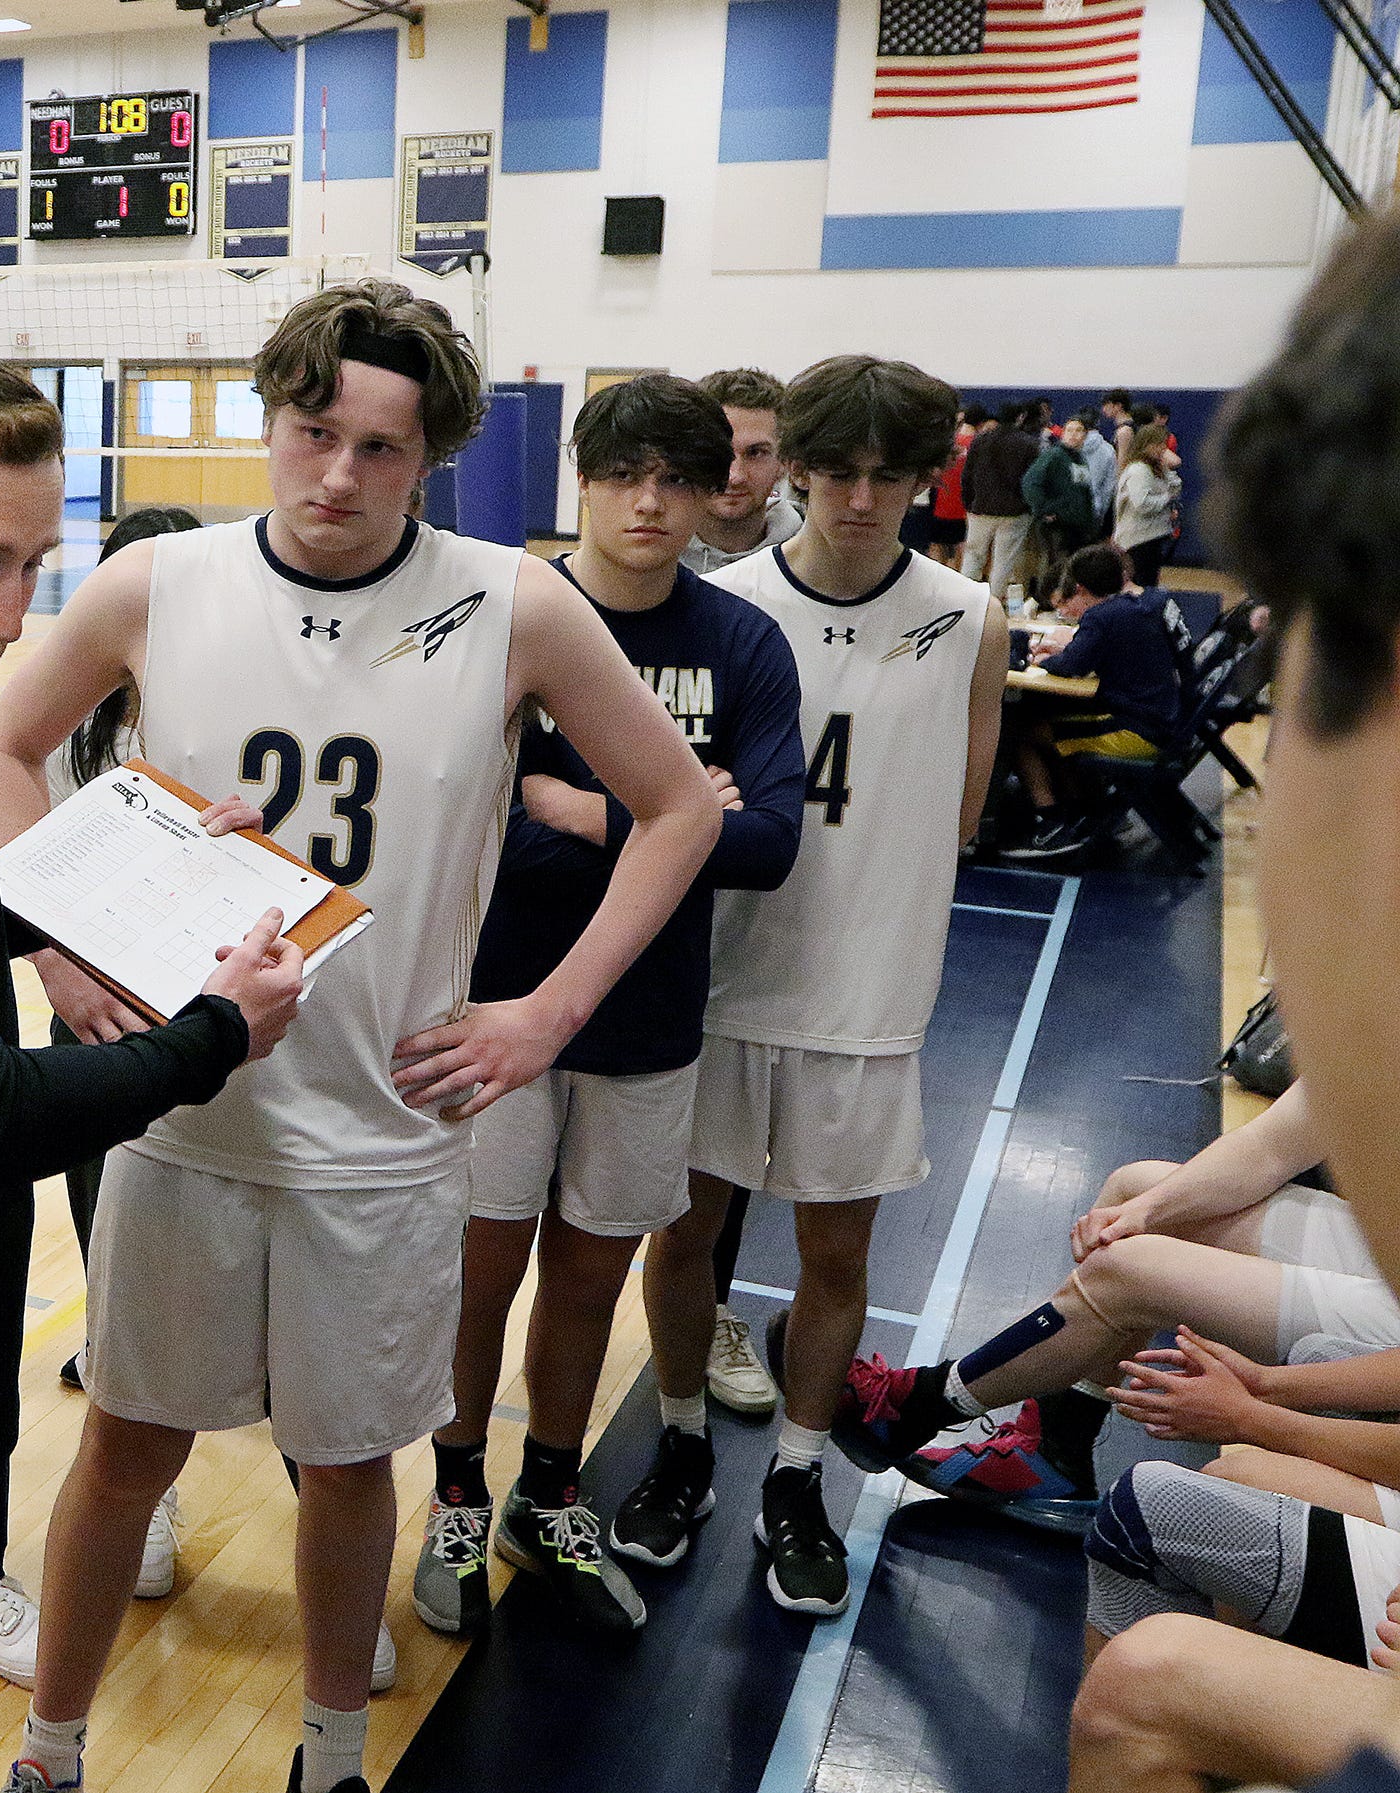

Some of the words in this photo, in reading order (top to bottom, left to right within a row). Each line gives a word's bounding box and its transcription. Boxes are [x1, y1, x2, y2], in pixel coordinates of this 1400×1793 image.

[151, 96, 191, 111] GUEST
[30, 105, 71, 119] NEEDHAM
[170, 111, 192, 148] 0
[50, 120, 71, 154] 0
[58, 155, 85, 166] BONUS
[133, 151, 161, 162] BONUS
[92, 175, 125, 185] PLAYER
[162, 171, 191, 181] FOULS
[30, 178, 58, 188] FOULS
[45, 190, 54, 221] 1
[118, 186, 129, 218] 1
[168, 181, 190, 218] 0
[31, 222, 54, 231] WON
[95, 219, 121, 229] GAME
[166, 216, 190, 226] WON
[16, 333, 30, 346] EXIT
[187, 332, 202, 345] EXIT
[803, 711, 854, 828] 4
[238, 726, 383, 890] 23
